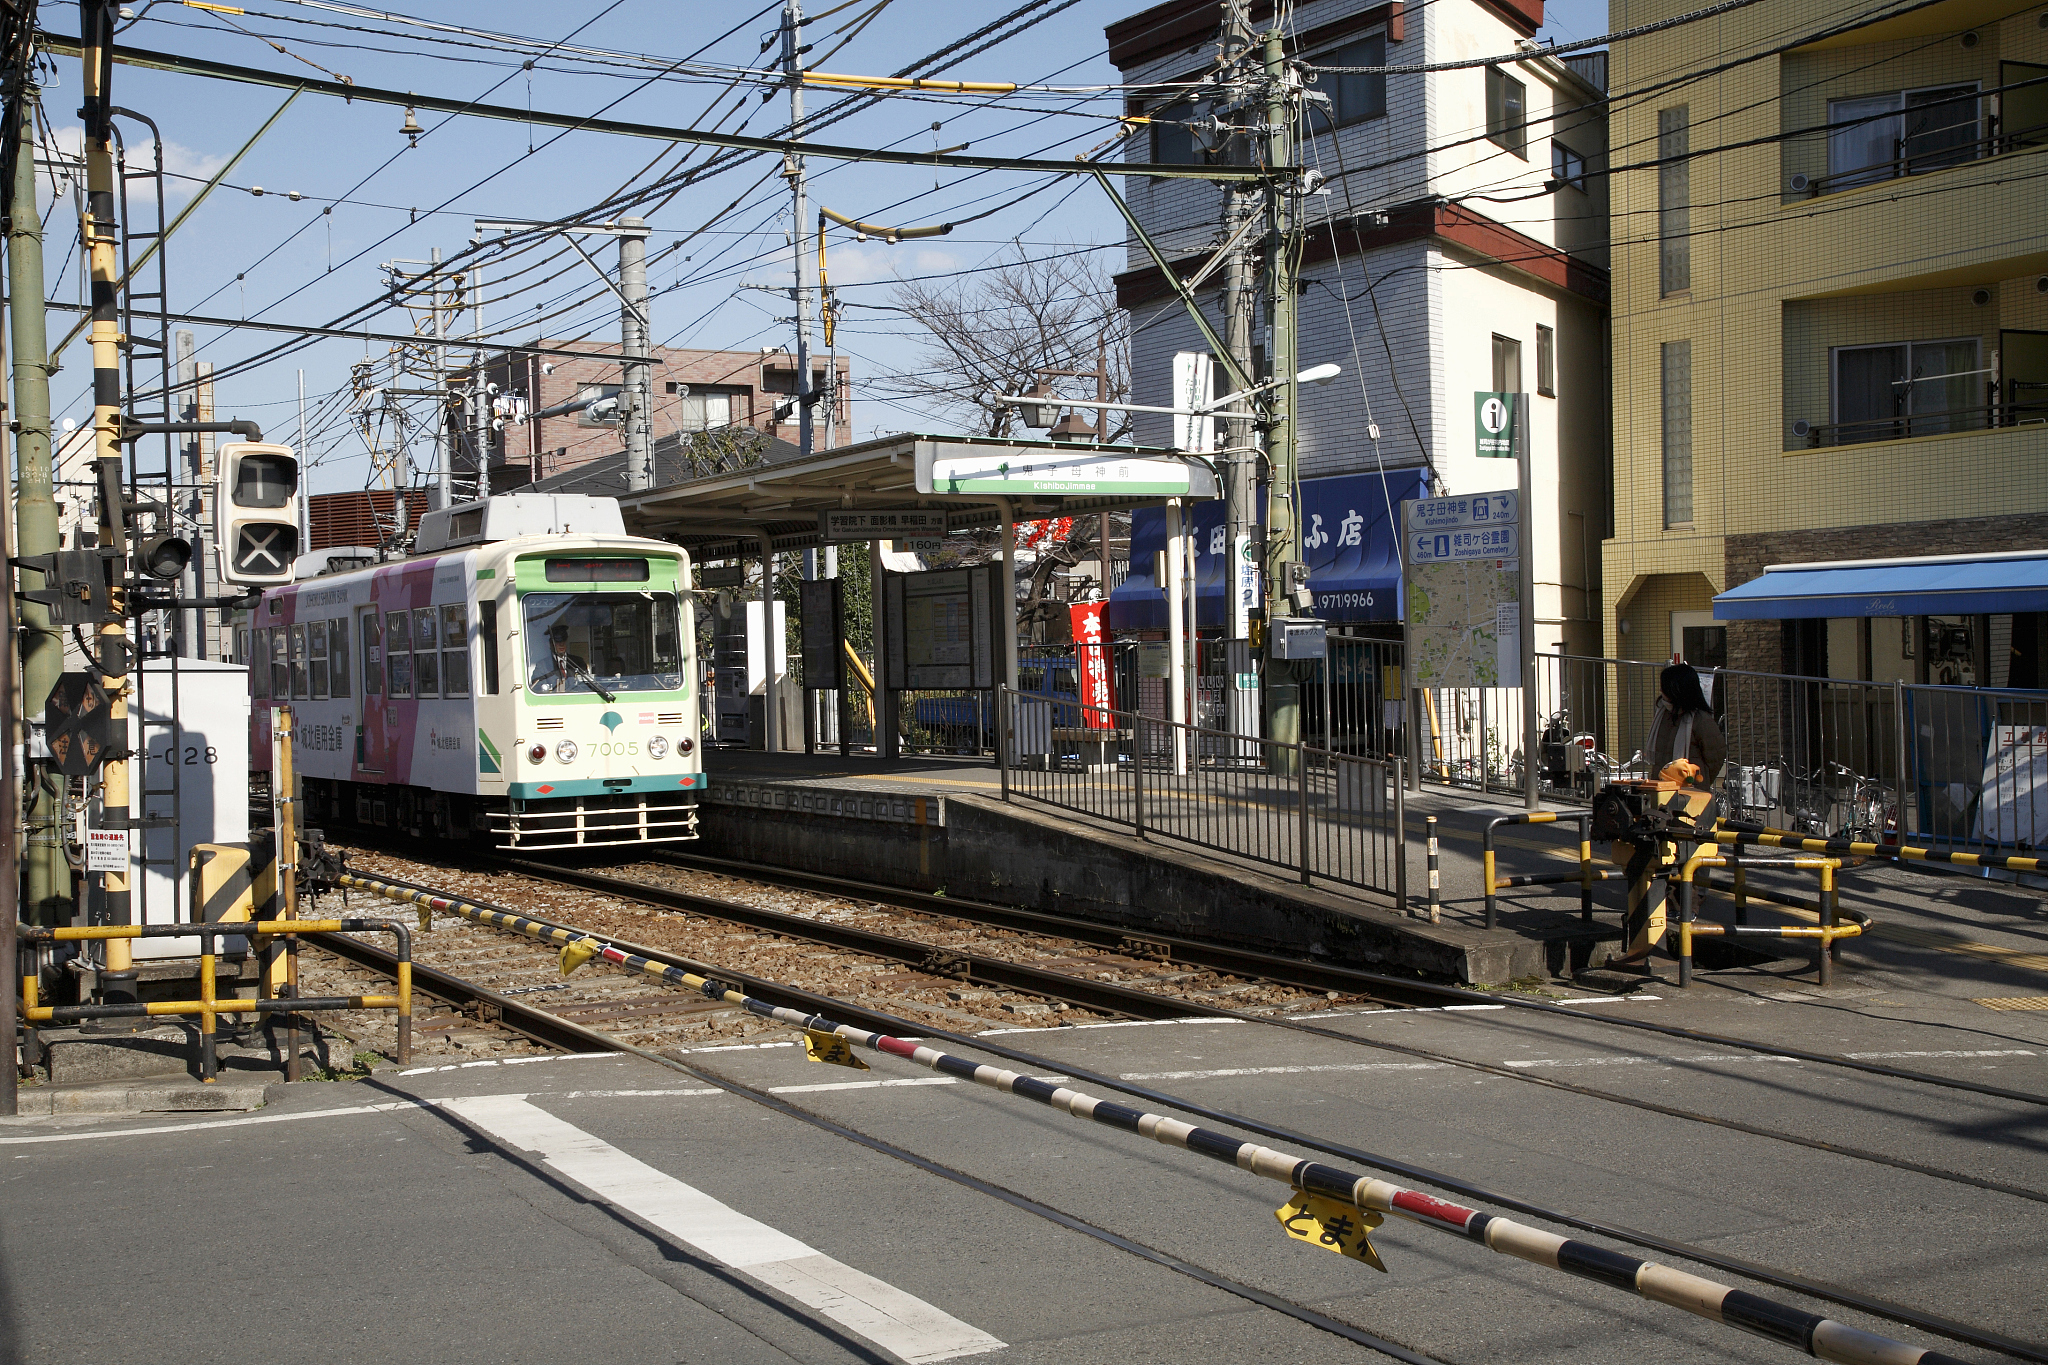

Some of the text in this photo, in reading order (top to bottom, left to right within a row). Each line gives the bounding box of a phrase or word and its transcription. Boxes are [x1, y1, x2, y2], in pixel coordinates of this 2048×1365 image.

[1023, 464, 1129, 478] 鬼子母神前
[1416, 500, 1468, 517] 鬼子母神堂
[1493, 511, 1510, 520] 240m
[830, 515, 866, 526] 学習院下
[870, 515, 897, 526] 面影橋
[901, 515, 927, 526] 早稲田
[909, 540, 941, 550] 160円
[1416, 545, 1509, 559] 460m Zoshigaya Cemetery
[1288, 628, 1319, 637] 電源ボックス
[300, 723, 343, 752] 城北信用金庫
[586, 741, 639, 758] 7005
